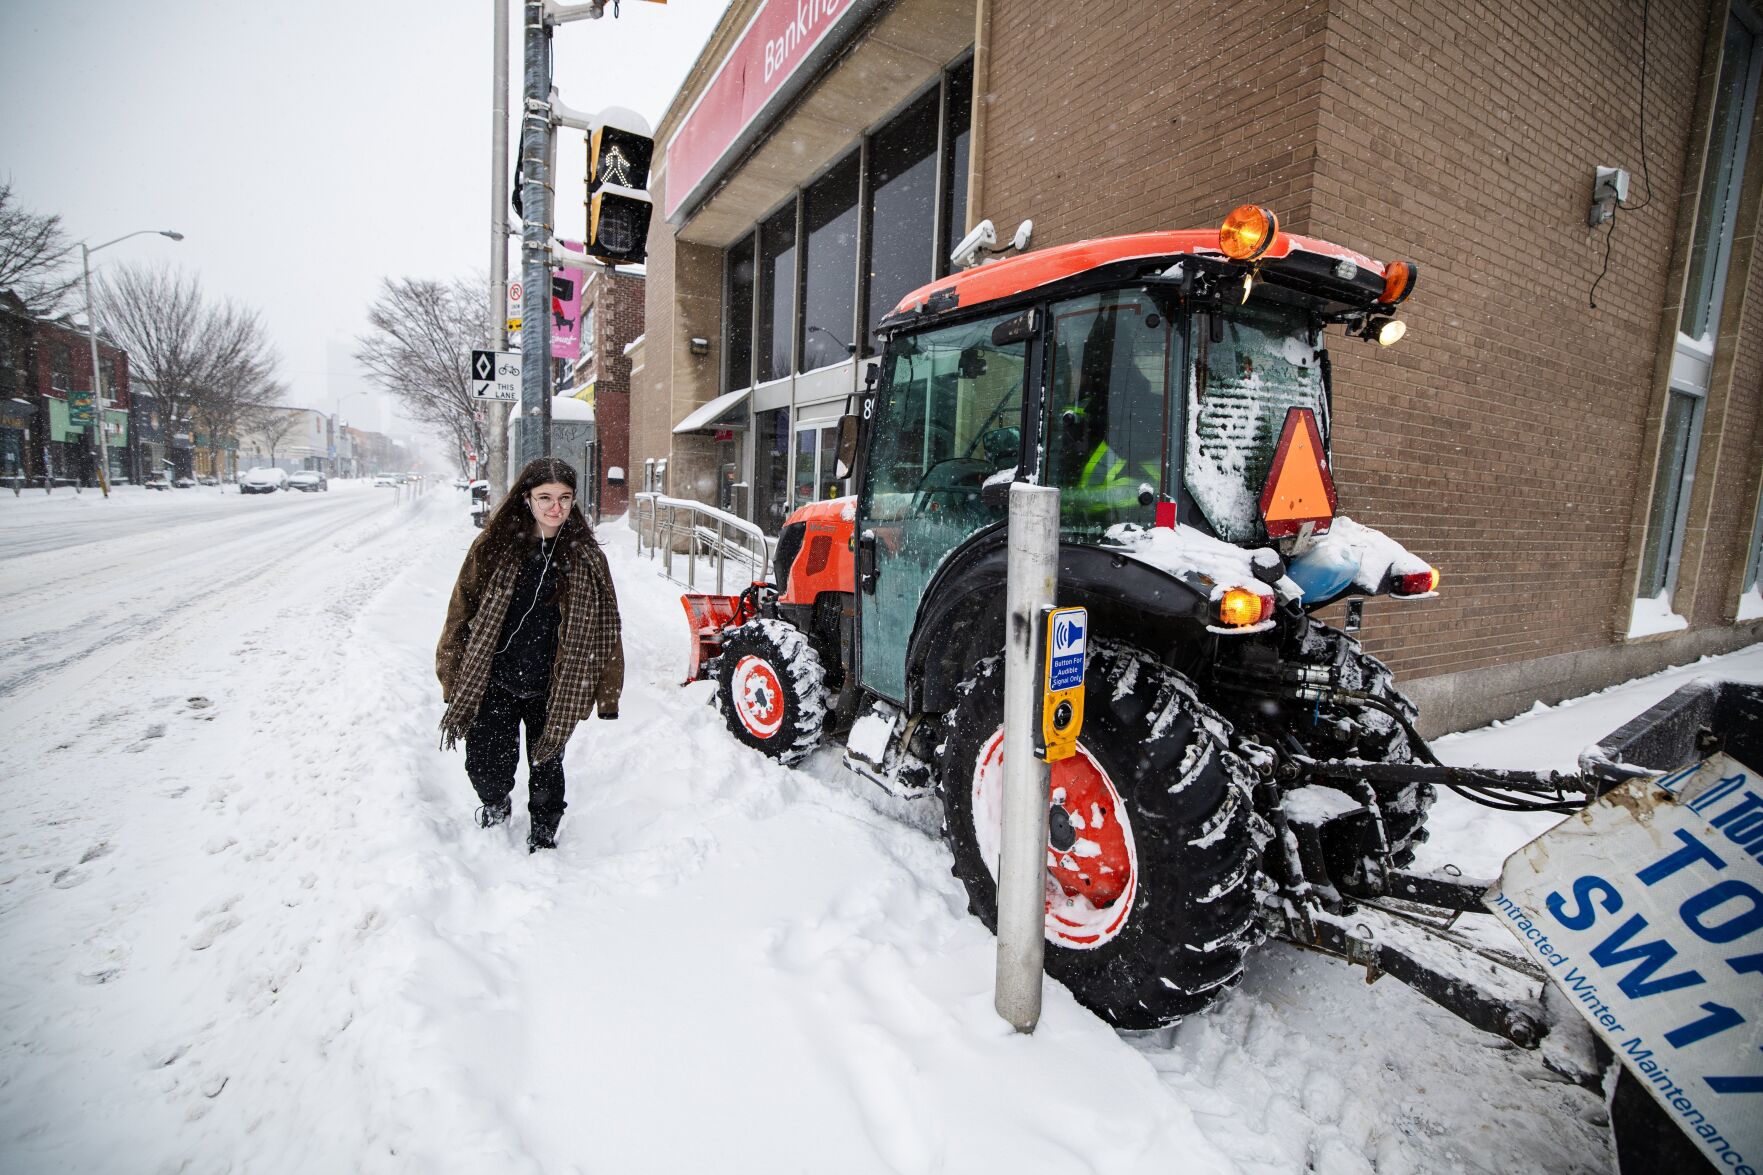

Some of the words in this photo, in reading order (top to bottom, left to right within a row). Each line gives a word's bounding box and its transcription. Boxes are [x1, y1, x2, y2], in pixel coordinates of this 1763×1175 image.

[497, 383, 514, 391] THIS
[495, 391, 516, 399] LANE
[1054, 659, 1073, 668] Button
[1057, 667, 1078, 676] Audible
[1053, 677, 1069, 687] Signal
[1069, 675, 1082, 683] Only
[1564, 967, 1625, 1034] Winter
[1620, 1036, 1758, 1175] Maintenance
